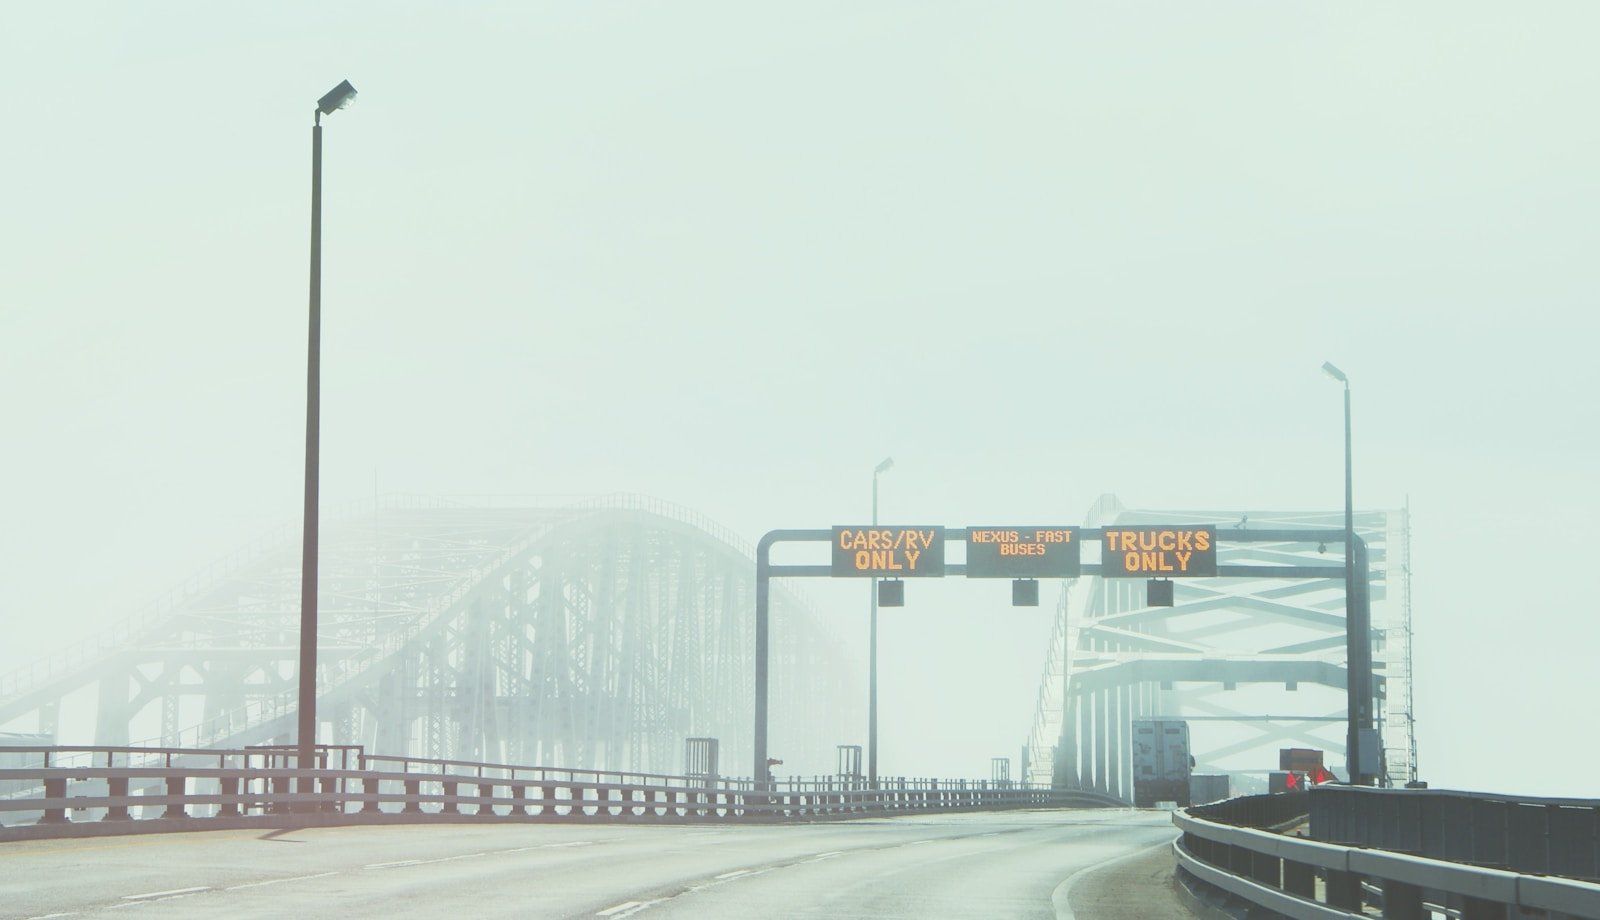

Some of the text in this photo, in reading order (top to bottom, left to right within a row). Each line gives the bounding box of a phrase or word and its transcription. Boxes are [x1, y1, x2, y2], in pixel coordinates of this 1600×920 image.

[839, 530, 935, 550] CARS/RV
[972, 531, 1019, 543] NEXUS
[1036, 531, 1073, 543] FAST
[1106, 530, 1211, 551] TRUCKS
[1000, 543, 1046, 556] BUSES
[854, 550, 920, 571] ONLY
[1124, 551, 1192, 572] ONLY
